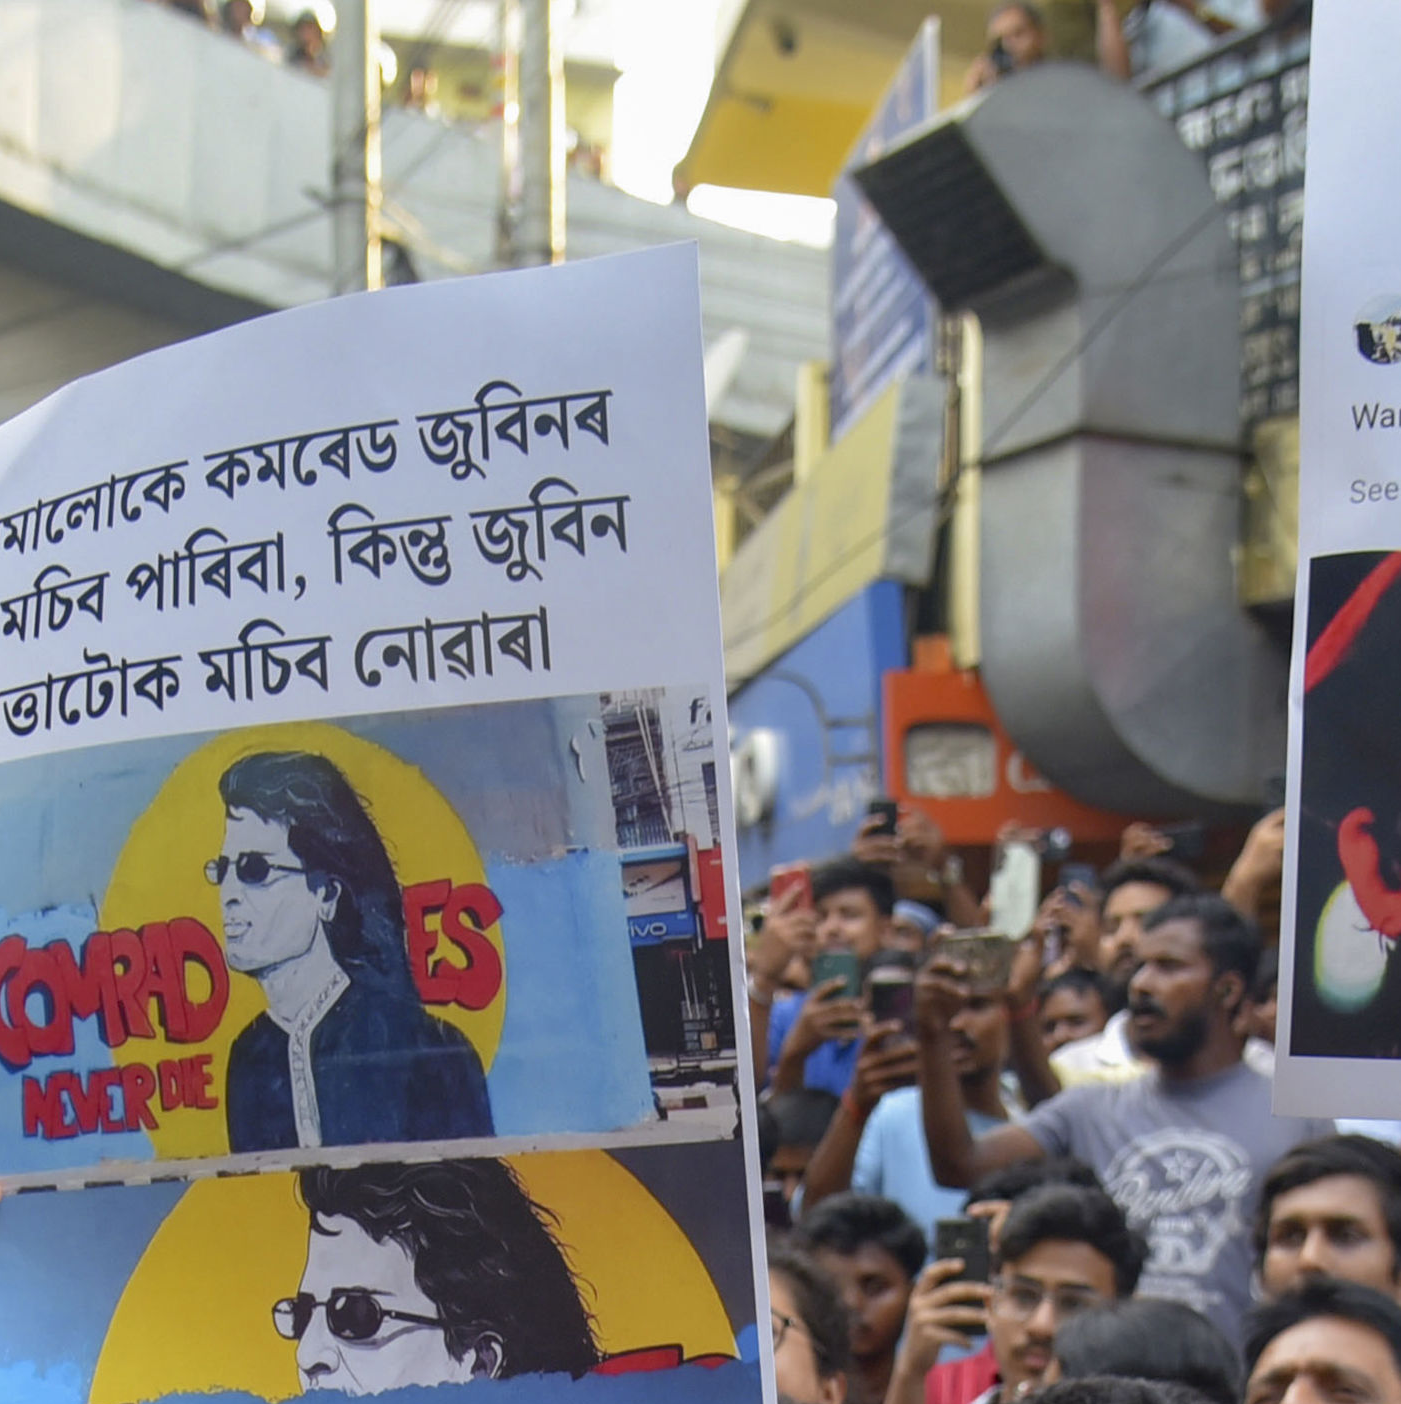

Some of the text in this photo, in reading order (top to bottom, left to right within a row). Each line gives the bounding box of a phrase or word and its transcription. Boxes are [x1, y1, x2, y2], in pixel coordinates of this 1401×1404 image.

[203, 419, 399, 499] কমৰেড
[415, 380, 613, 480] জুবিনৰ
[1350, 478, 1399, 504] See
[0, 565, 110, 641] মচিব
[125, 527, 306, 611] পাৰিবা,
[327, 503, 452, 585] কিন্তু
[469, 477, 631, 581] জুবিন
[197, 618, 332, 701] মচিব
[354, 605, 551, 686] নোৱাৰা
[630, 921, 667, 938] ivo
[23, 1053, 220, 1140] NEVER DIE
